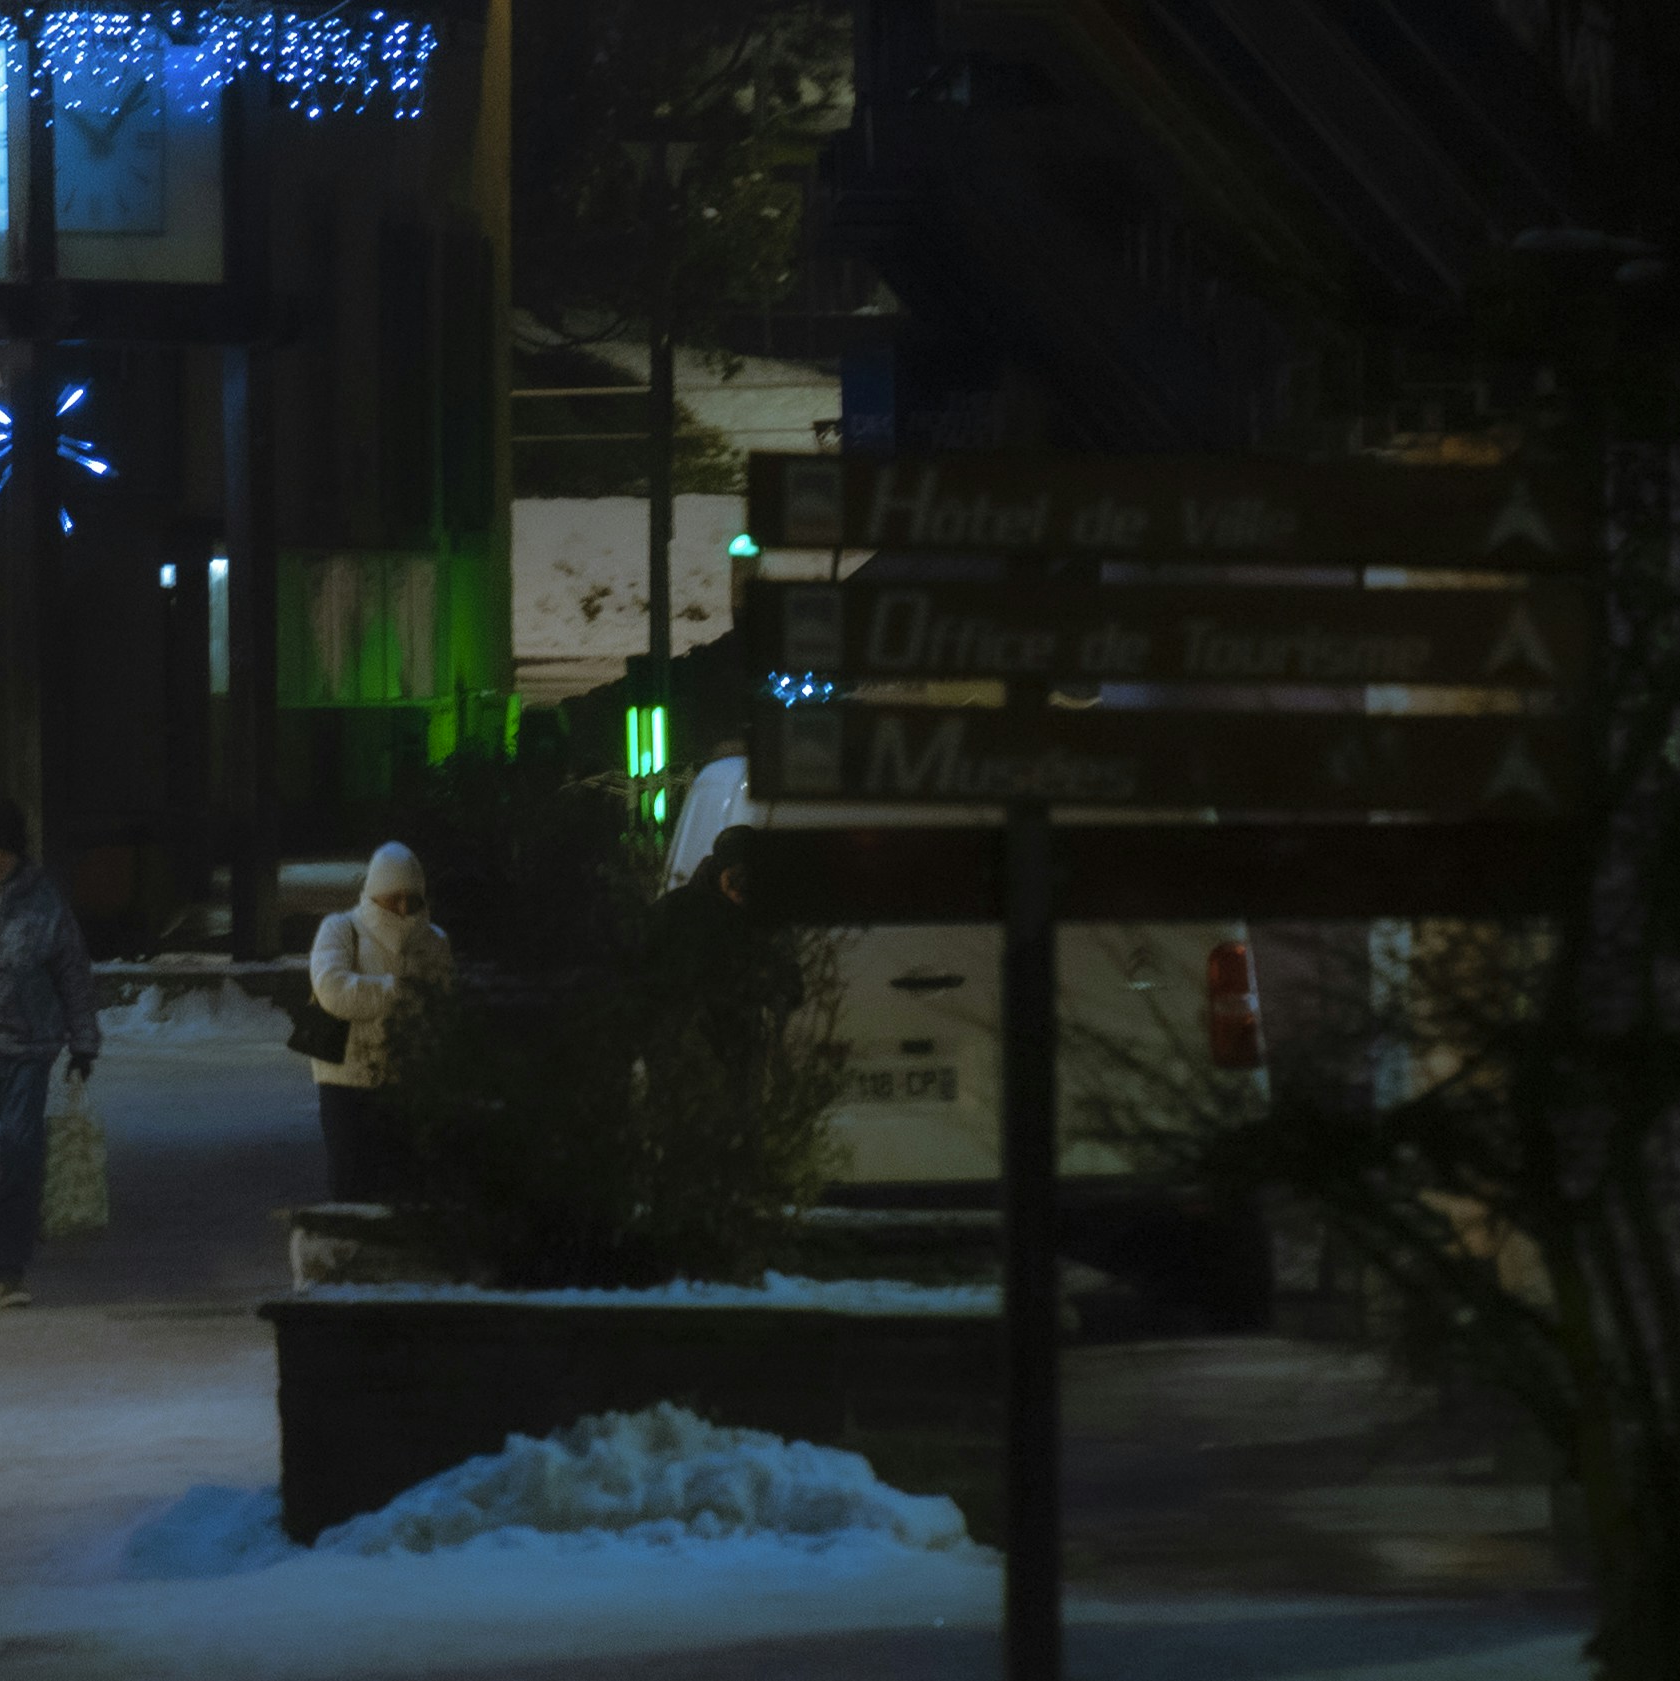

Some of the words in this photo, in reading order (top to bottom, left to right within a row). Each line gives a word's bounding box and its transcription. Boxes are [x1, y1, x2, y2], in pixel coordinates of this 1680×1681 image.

[1073, 489, 1148, 546] de
[1180, 495, 1301, 546] Ville
[865, 589, 1057, 672] Office
[1079, 619, 1150, 674] de
[1182, 616, 1435, 676] Tourisme
[863, 715, 1139, 800] Musées
